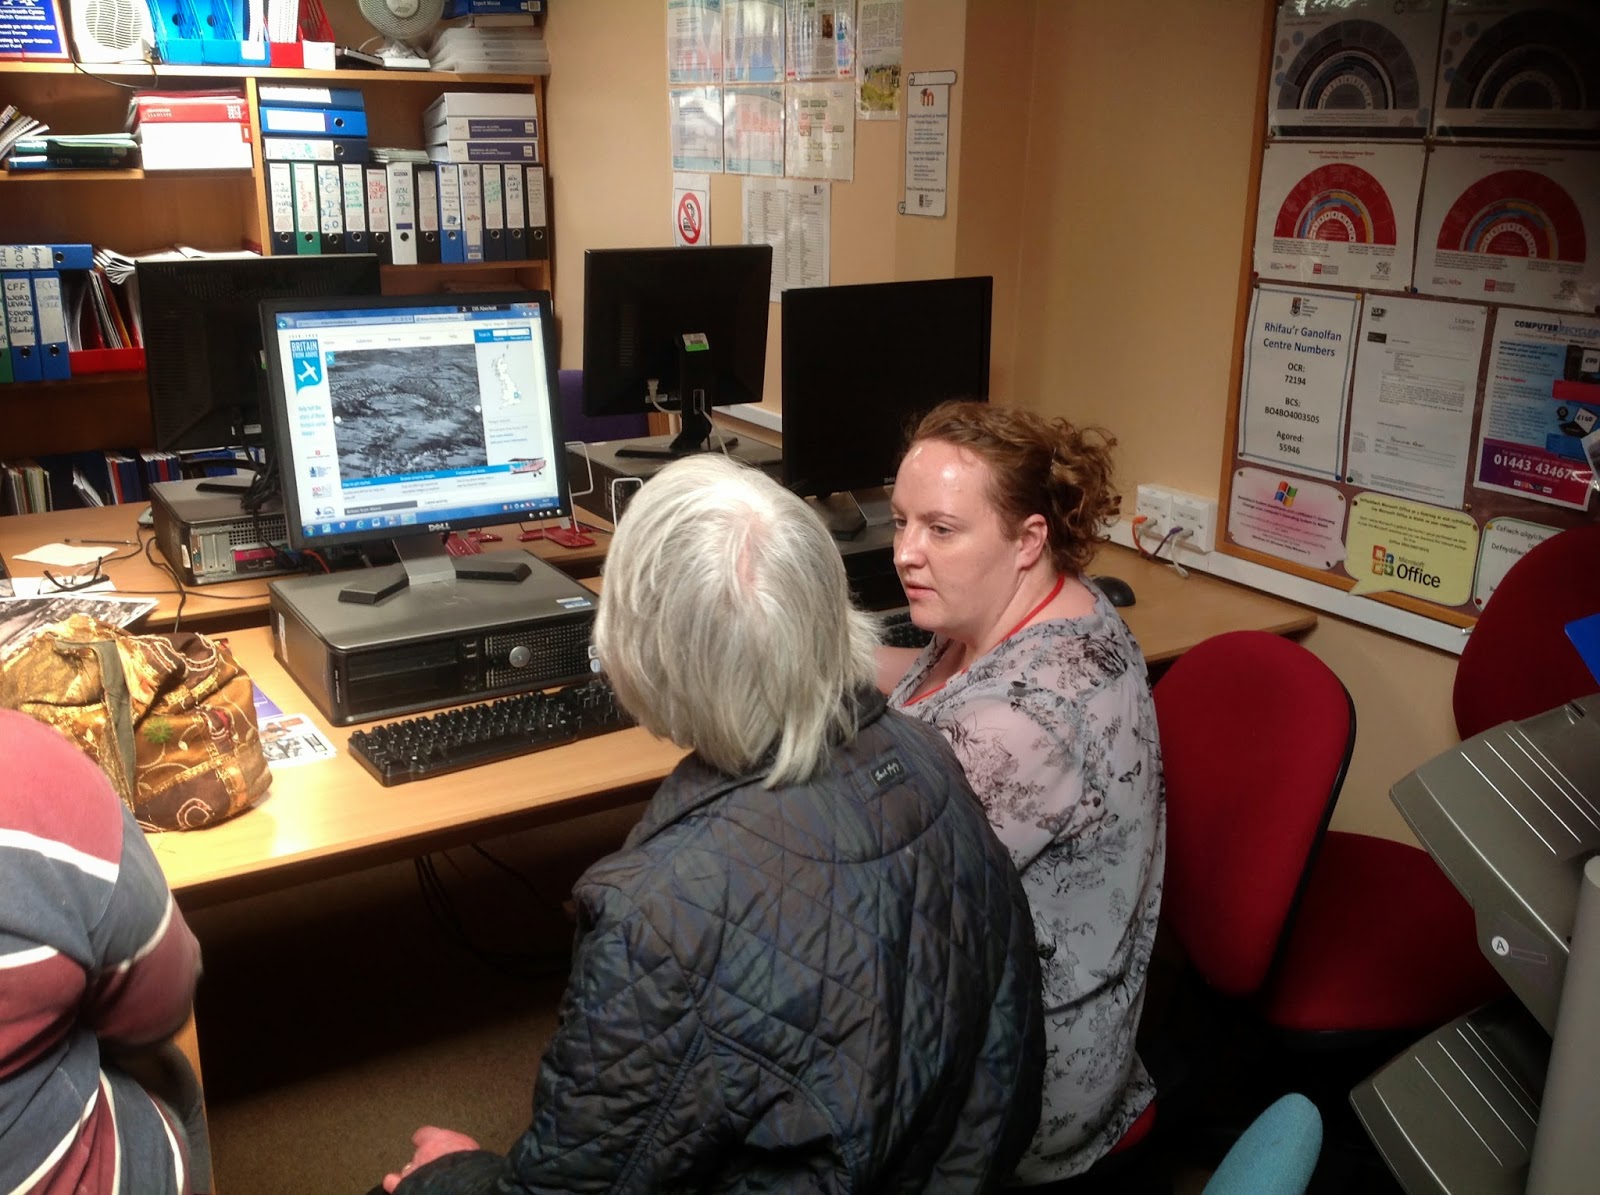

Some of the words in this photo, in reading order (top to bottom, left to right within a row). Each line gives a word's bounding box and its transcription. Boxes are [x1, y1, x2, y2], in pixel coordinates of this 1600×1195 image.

[1514, 320, 1559, 332] COMPUTER
[1300, 326, 1342, 342] Ganolfan
[291, 341, 318, 352] BRITAIN
[1263, 337, 1292, 351] Centre
[1294, 342, 1336, 357] Numbers
[1287, 362, 1306, 373] OCR:
[1284, 375, 1307, 386] 72194
[1285, 397, 1301, 408] BCS:
[1276, 430, 1305, 443] Agored:
[1279, 443, 1300, 455] 55946
[1493, 453, 1532, 471] 01443
[428, 522, 451, 531] DELL
[1496, 524, 1519, 535] Cofiwch
[1396, 563, 1441, 588] Office
[1496, 940, 1506, 952] A
